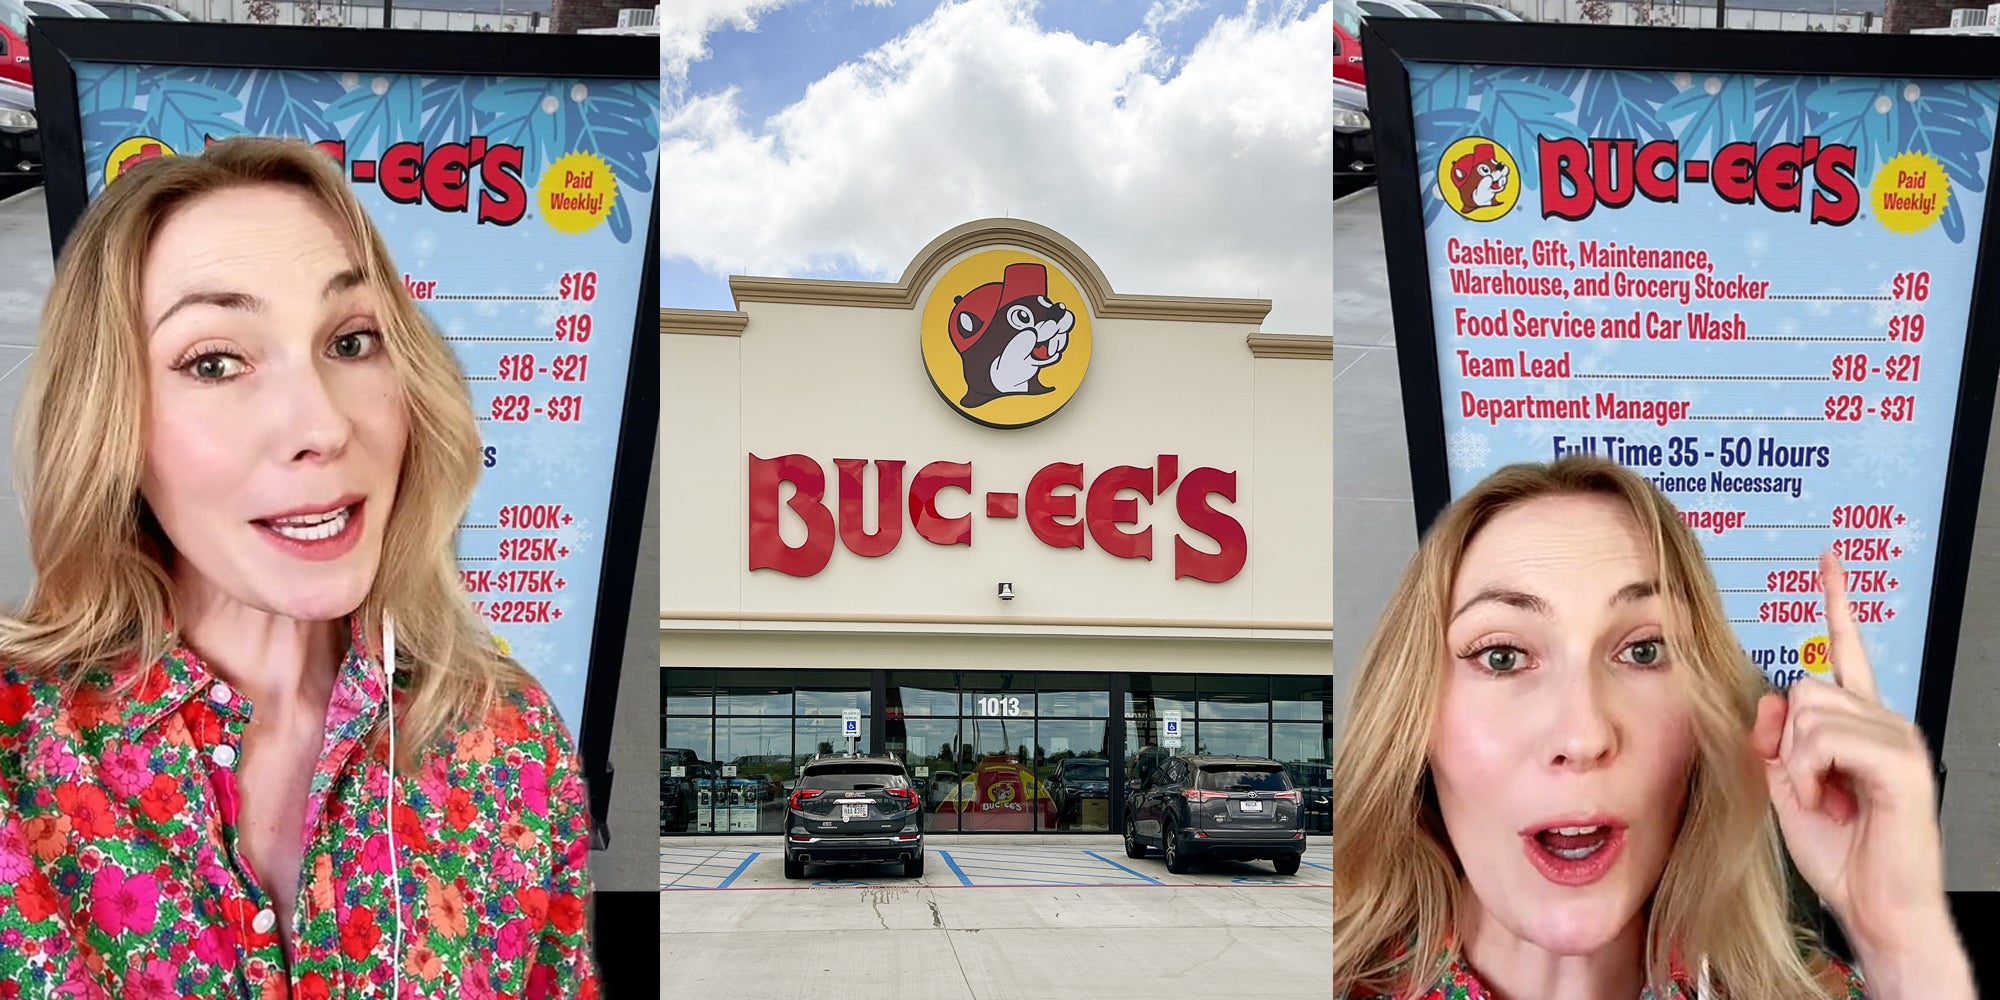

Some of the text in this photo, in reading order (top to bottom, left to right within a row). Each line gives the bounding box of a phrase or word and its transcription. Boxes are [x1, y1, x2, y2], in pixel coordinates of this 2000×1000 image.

[565, 170, 593, 189] Paid
[1537, 132, 1861, 227] BUC-EE'S
[1897, 170, 1927, 189] Paid
[550, 192, 604, 215] Weekly!
[1883, 192, 1936, 215] Weekly!
[1448, 238, 1714, 273] Cashier, Gift, Maintenance,
[559, 272, 597, 302] $16
[1451, 270, 1930, 304] Warehouse, and Grocery Stocker $16
[555, 314, 592, 343] $19
[1456, 308, 1926, 343] Food Service and Car Wash $19
[498, 354, 534, 382] $18
[553, 355, 588, 382] $21
[1458, 350, 1515, 377] Team
[1521, 352, 1571, 378] Lead
[1831, 354, 1868, 381] $18
[1885, 355, 1921, 381] $21
[492, 395, 531, 422] $23
[547, 396, 582, 422] $31
[1462, 392, 1590, 425] Department
[1596, 393, 1690, 426] Manager
[1824, 396, 1864, 421] $23
[1880, 396, 1915, 422] $31
[1603, 437, 1662, 466] Time
[1668, 437, 1699, 466] 35
[1720, 437, 1752, 466] 50
[1758, 438, 1830, 467] Hours
[1644, 472, 1802, 497] rience Necessary
[499, 505, 573, 529] $100K+
[748, 452, 1248, 583] BUC-EE'S
[1673, 506, 1906, 534] anager $100K+
[499, 539, 569, 561] $125K+
[1832, 539, 1902, 561] $125K+
[1752, 648, 1775, 670] up
[1780, 646, 1799, 664] to
[978, 697, 1020, 716] 1013
